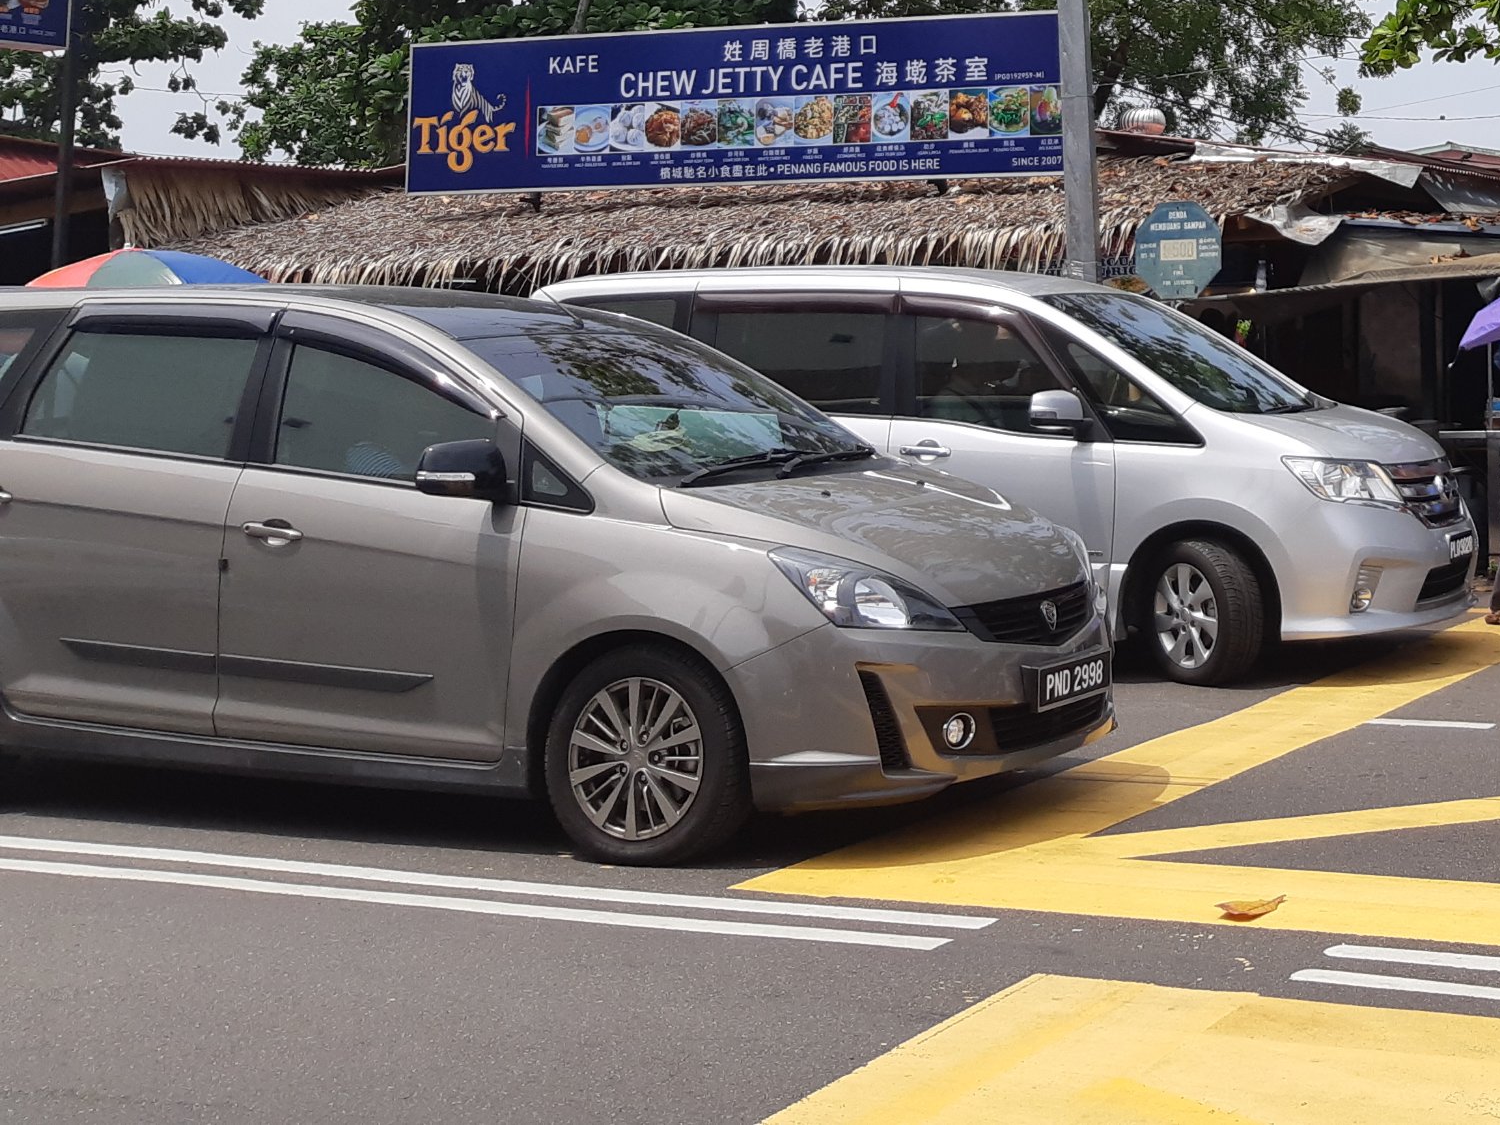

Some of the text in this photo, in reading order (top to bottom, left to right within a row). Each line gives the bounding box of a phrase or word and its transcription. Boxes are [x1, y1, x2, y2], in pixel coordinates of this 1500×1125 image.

[724, 35, 877, 62] 姓周橋老港口
[549, 55, 599, 74] KAFE
[620, 56, 989, 97] CHEW JETTY CAFE 海墘茶室
[413, 110, 516, 173] Tiger
[777, 163, 821, 175] PENANG
[823, 161, 867, 173] FAMOUS
[869, 160, 897, 172] FOOD
[899, 160, 909, 171] IS
[911, 158, 940, 170] HERE
[1011, 155, 1063, 167] SINCE 2007
[1046, 659, 1104, 700] PND 2998
